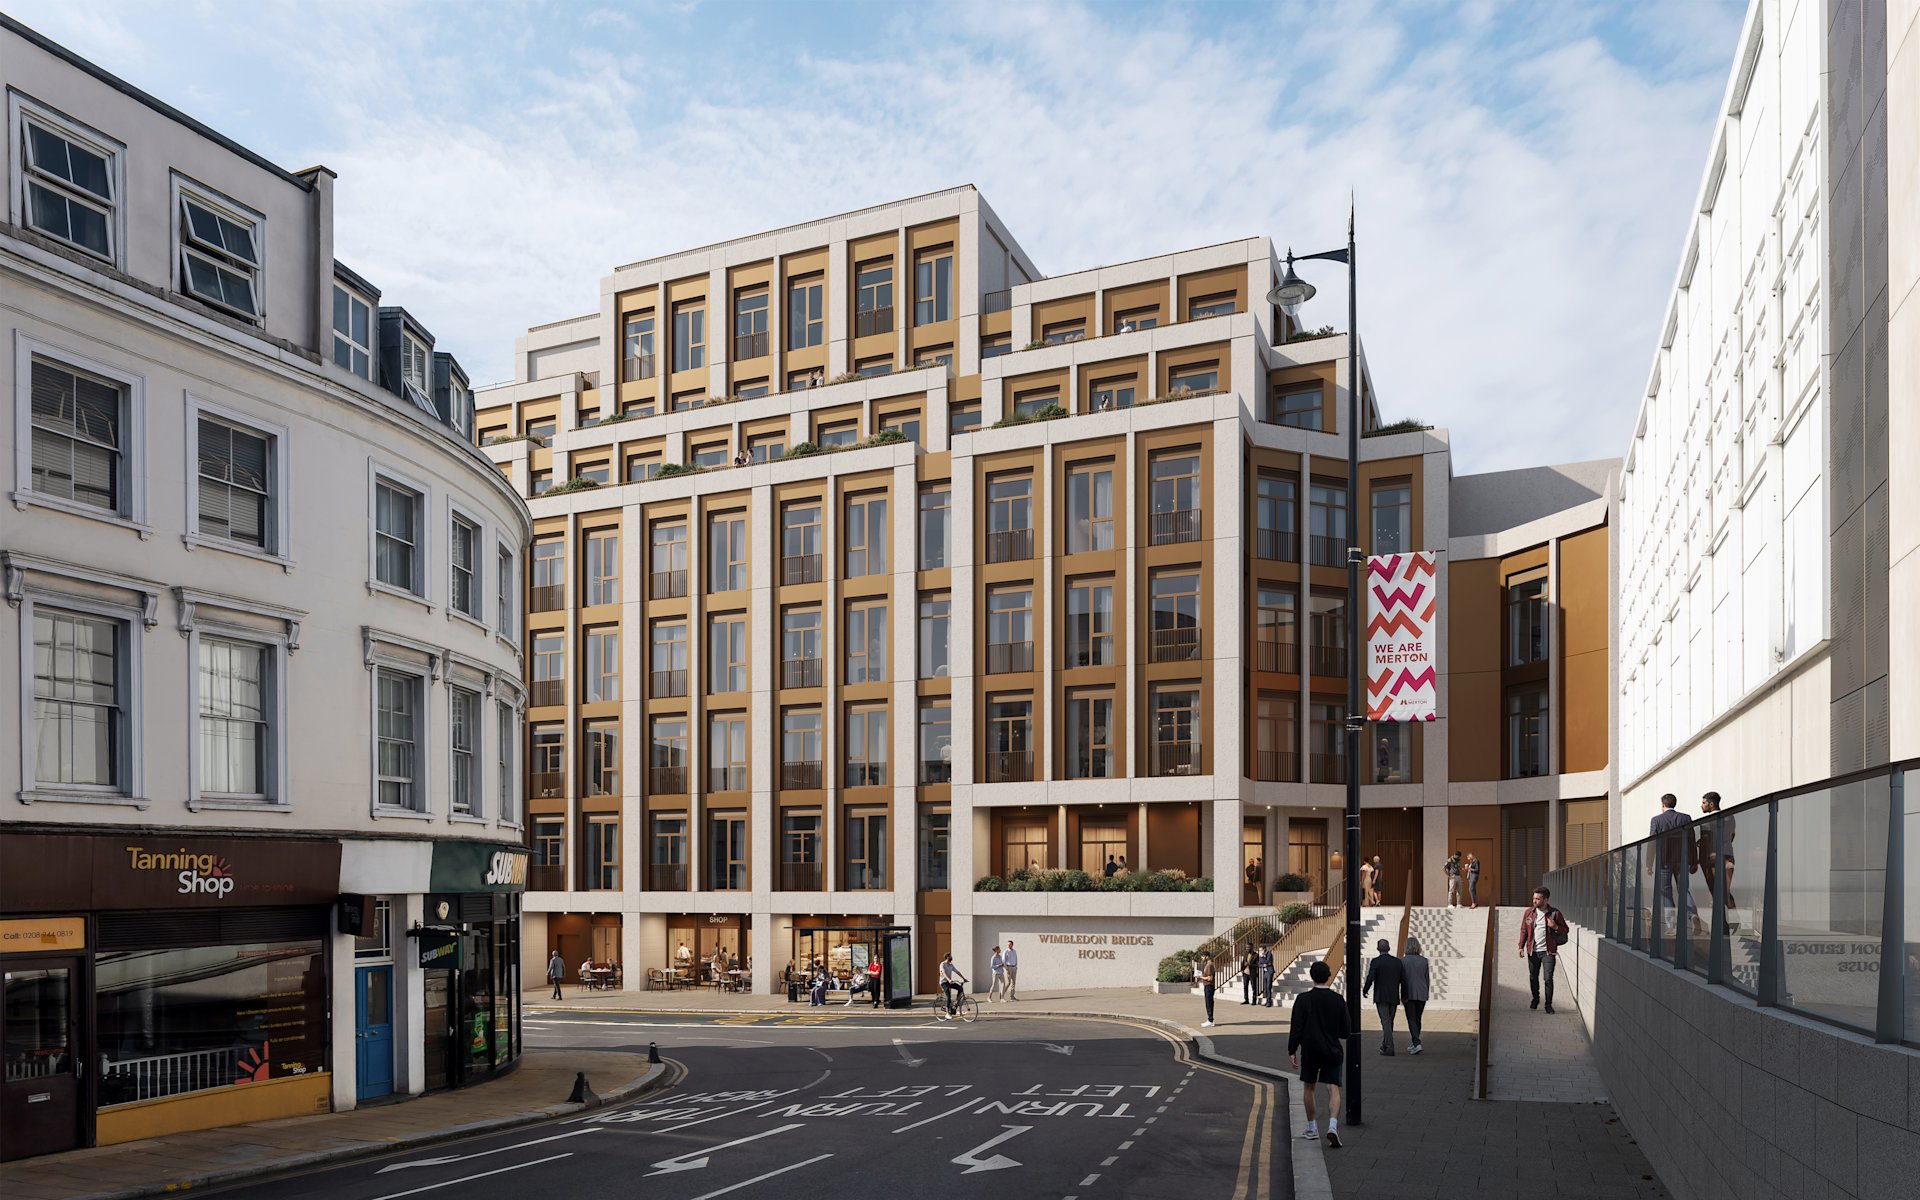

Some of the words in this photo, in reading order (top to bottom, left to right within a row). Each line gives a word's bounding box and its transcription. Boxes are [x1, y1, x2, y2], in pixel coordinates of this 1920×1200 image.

[1375, 644, 1394, 653] WE
[1398, 642, 1422, 652] ARE
[1375, 652, 1428, 664] MERTON
[126, 847, 213, 876] Tanning
[178, 870, 234, 899] Shop
[709, 916, 728, 924] SHOP
[22, 931, 41, 939] 0208
[1038, 935, 1107, 945] WIMBLEDON
[1111, 936, 1154, 946] BRIDGE
[420, 941, 458, 964] SUBWAY
[1078, 949, 1116, 960] HOUSE
[818, 1085, 973, 1098] LEFT
[1011, 1084, 1161, 1098] LEFT
[756, 1101, 923, 1117] TURN
[973, 1100, 1136, 1118] TURN
